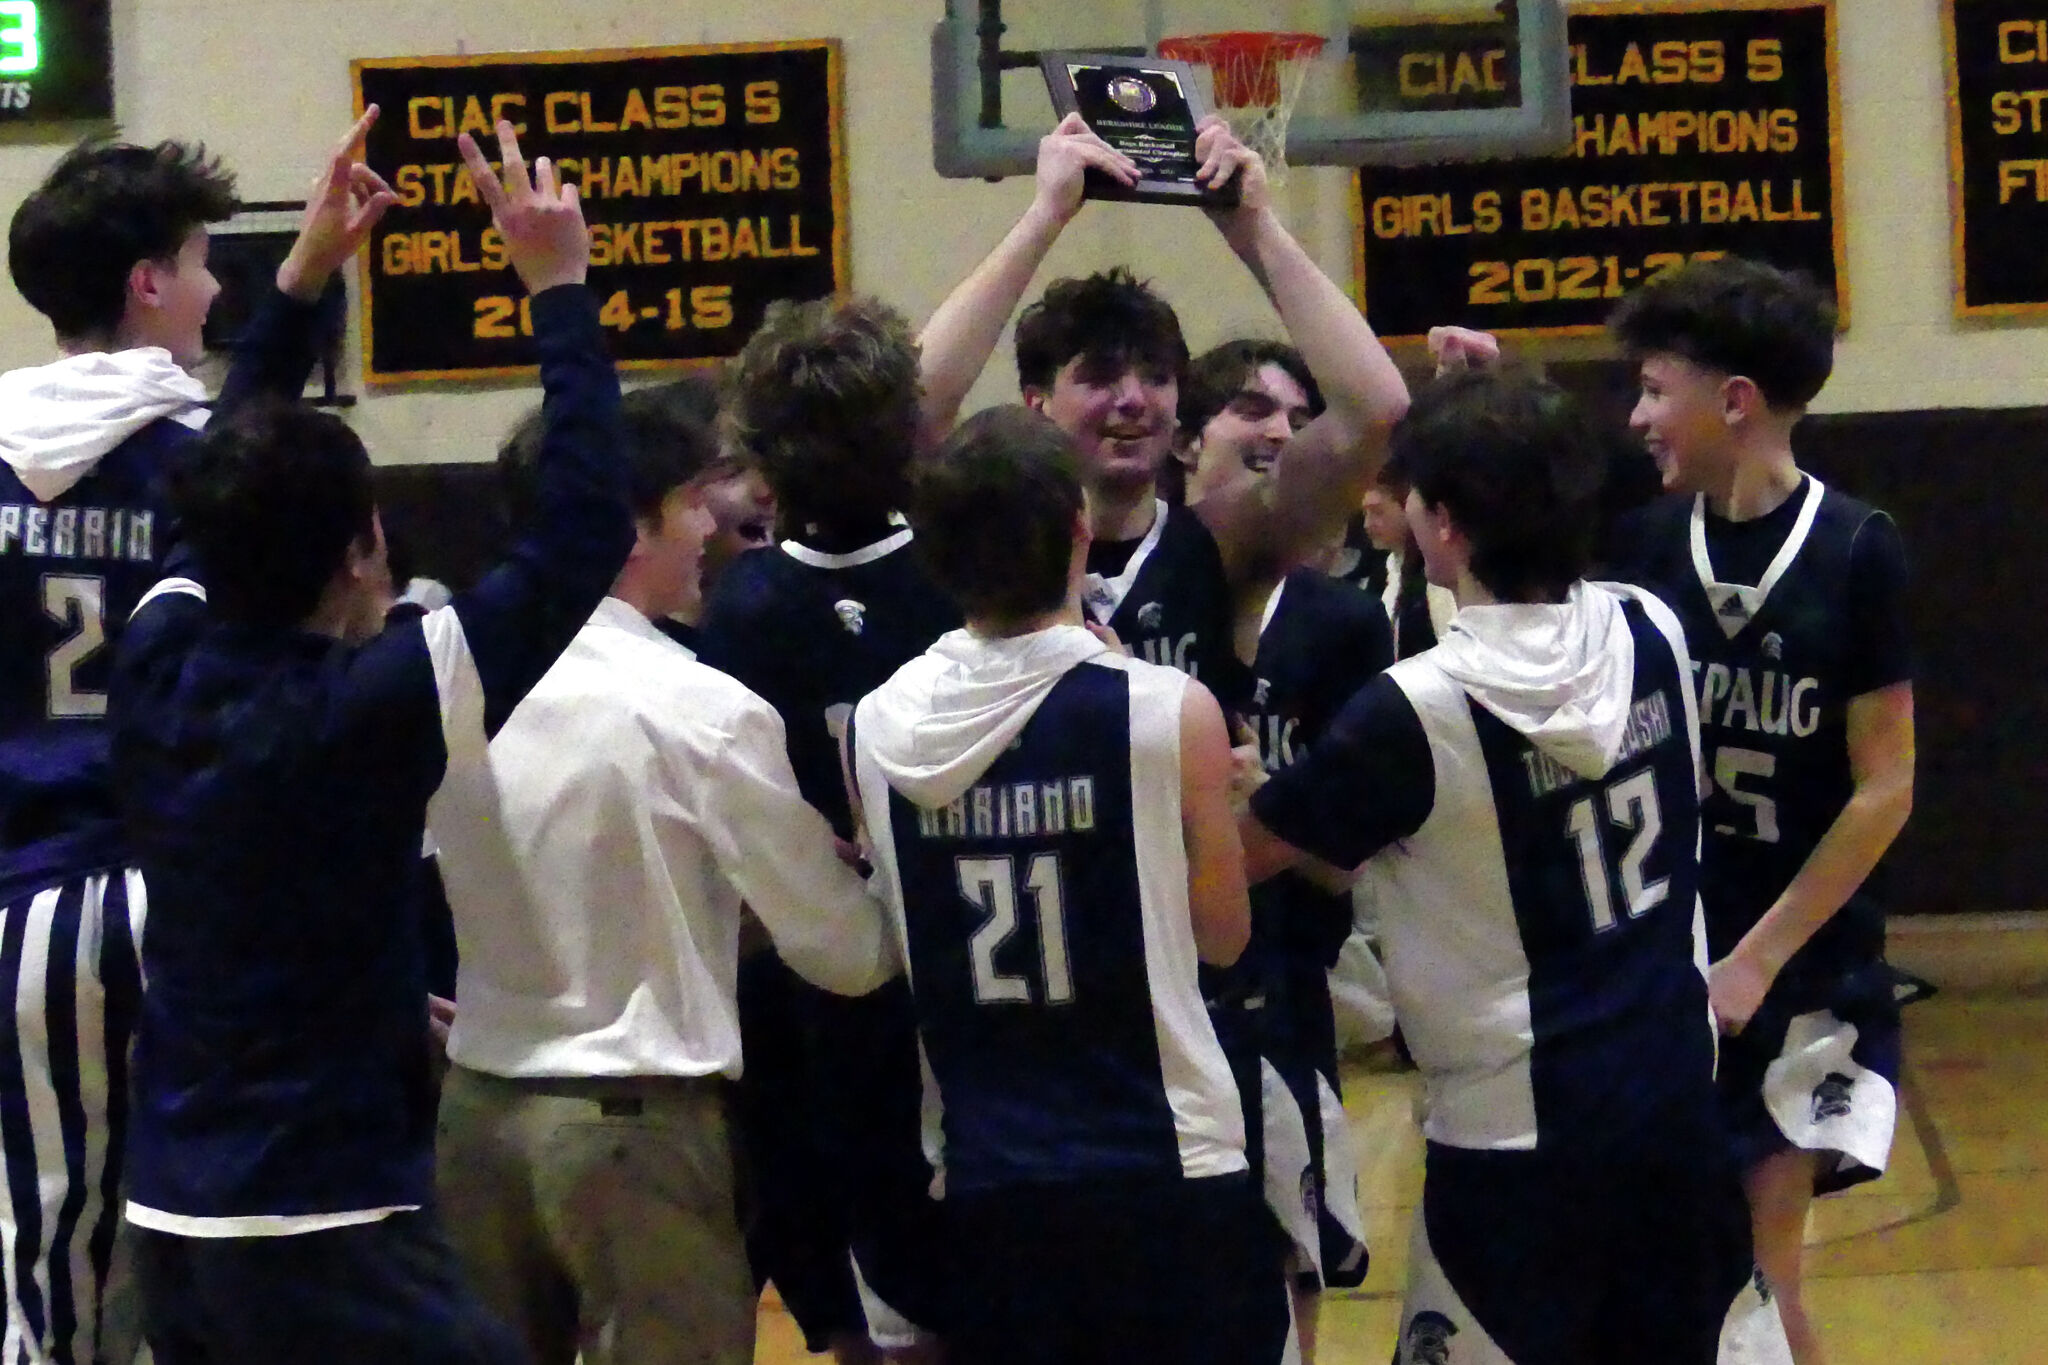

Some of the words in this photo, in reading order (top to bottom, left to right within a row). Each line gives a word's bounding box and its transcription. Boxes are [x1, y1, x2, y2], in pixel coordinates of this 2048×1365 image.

[1399, 49, 1506, 98] CIAC
[1568, 39, 1726, 85] LASS
[1746, 38, 1784, 82] S
[408, 93, 528, 140] CIAC
[544, 84, 726, 134] CLASS
[744, 80, 781, 124] S
[1568, 108, 1799, 157] HAMPIONS
[1371, 190, 1503, 239] GIRLS
[1521, 179, 1822, 232] BASKETBALL
[382, 227, 510, 275] GIRLS
[588, 215, 820, 267] SKETBALL
[1467, 251, 1728, 305] 2021-2
[473, 284, 734, 339] 24-15
[0, 502, 155, 561] PERRIN
[41, 573, 108, 719] 2
[1689, 658, 1821, 738] PAUG
[1565, 764, 1672, 934] 12
[954, 851, 1076, 1005] 21
